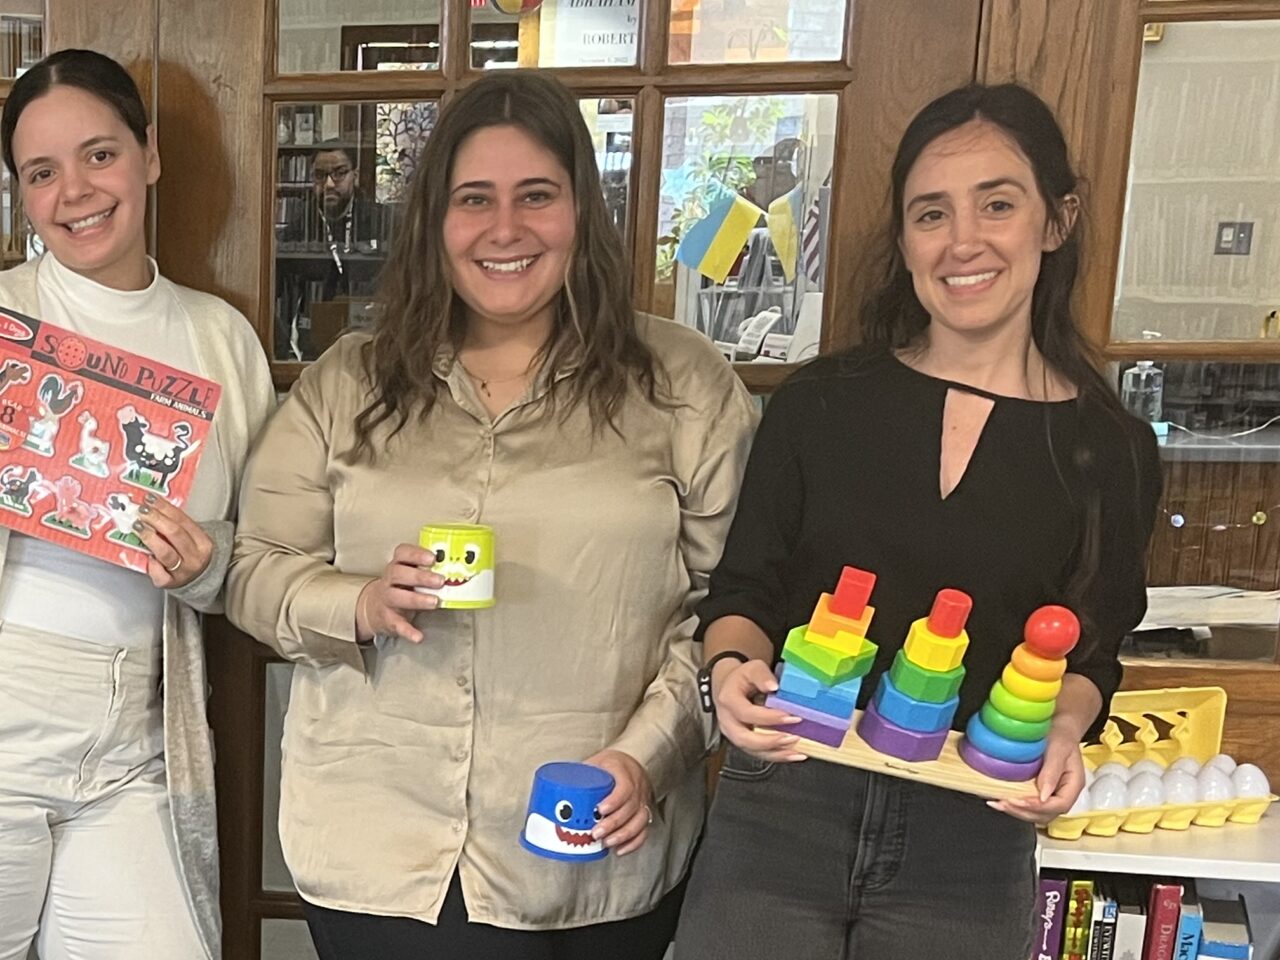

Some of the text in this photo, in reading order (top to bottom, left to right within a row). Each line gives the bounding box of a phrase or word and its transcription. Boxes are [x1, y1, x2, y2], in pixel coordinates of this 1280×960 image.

[582, 32, 636, 45] ROBERT
[137, 365, 215, 410] PUZZLE
[0, 406, 15, 425] 8
[150, 393, 208, 420] FARM ANIMALS
